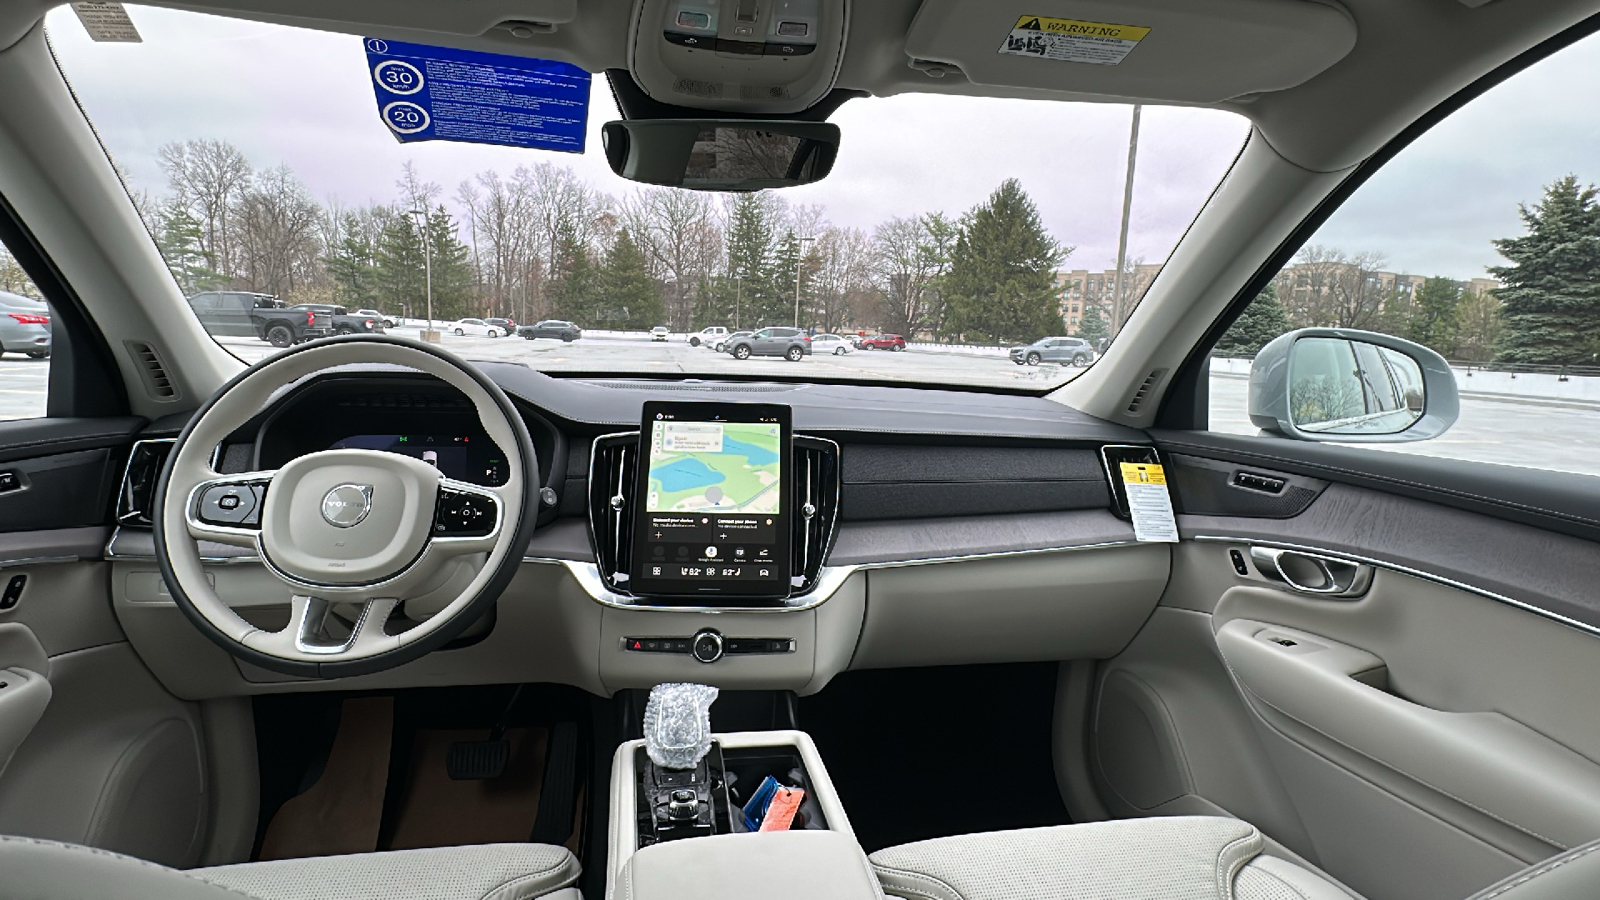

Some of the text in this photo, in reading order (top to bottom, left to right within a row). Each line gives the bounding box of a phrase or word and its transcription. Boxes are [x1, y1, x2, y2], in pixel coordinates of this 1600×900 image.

[1047, 22, 1121, 36] WARNING
[386, 71, 413, 84] 30
[394, 111, 419, 123] 20
